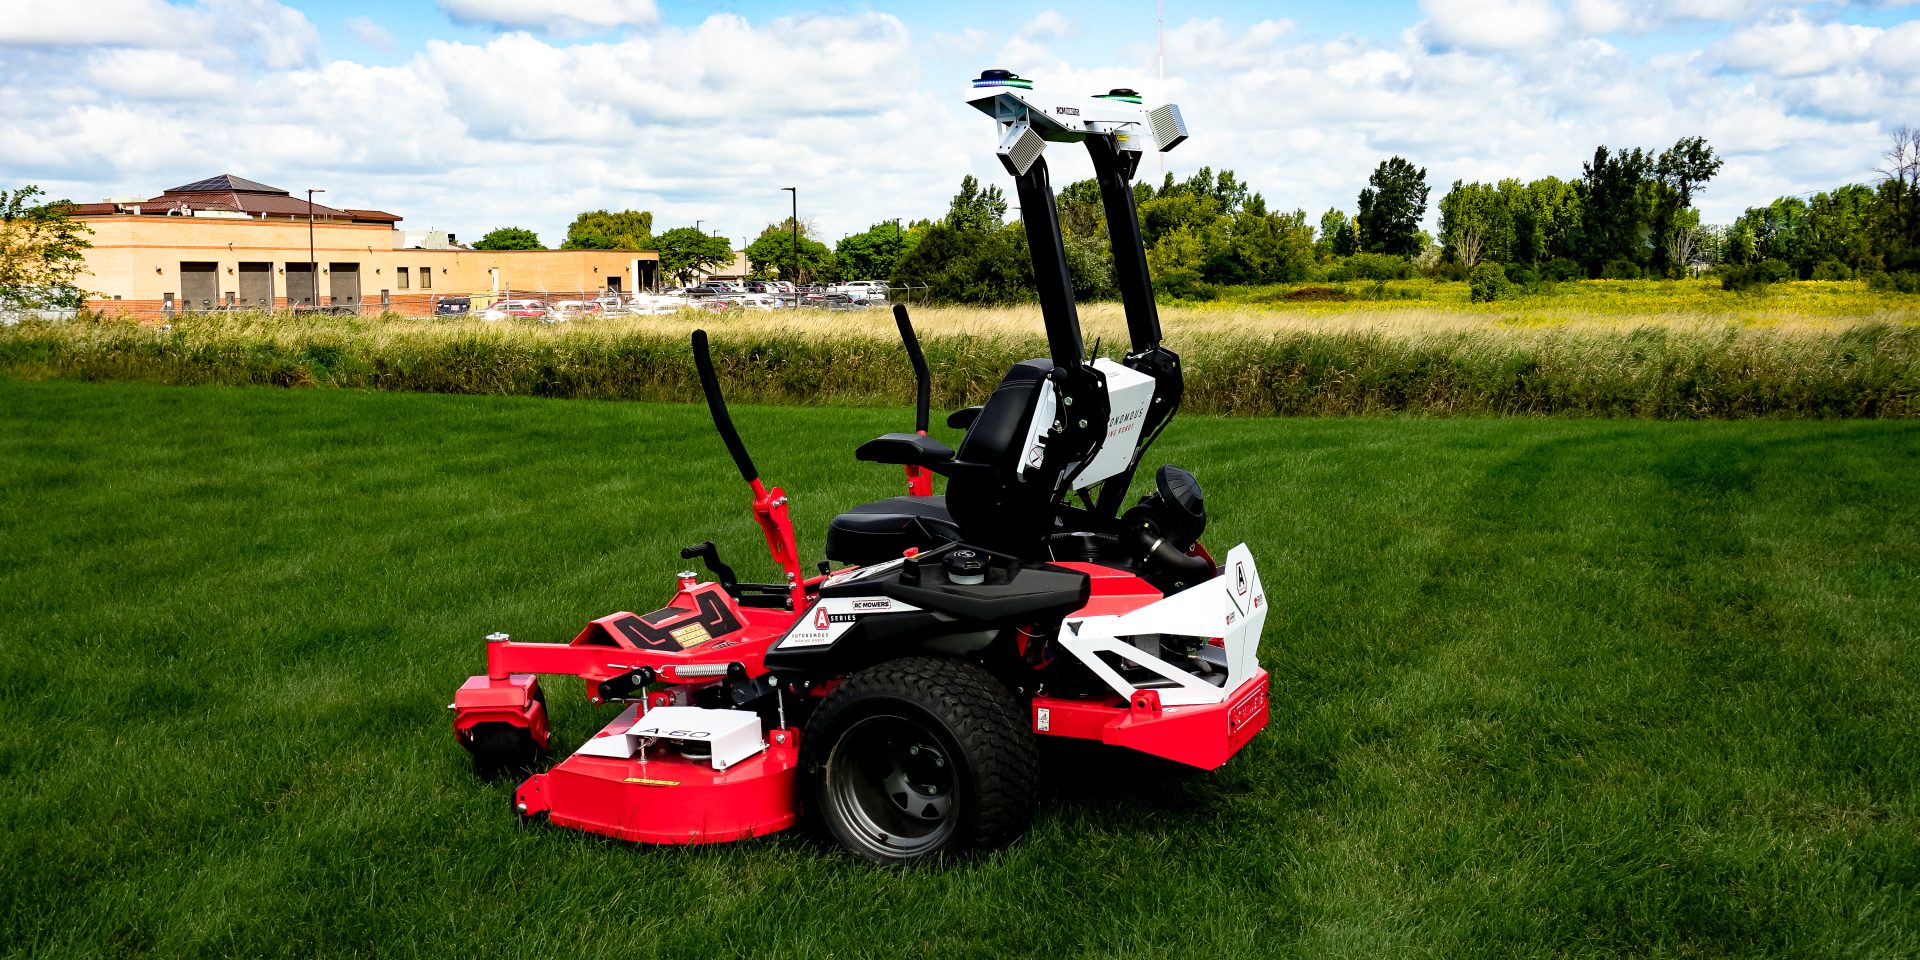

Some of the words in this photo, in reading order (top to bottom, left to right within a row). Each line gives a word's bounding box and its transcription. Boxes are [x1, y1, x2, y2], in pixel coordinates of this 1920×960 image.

[1108, 407, 1144, 428] ONOMOUS
[817, 610, 828, 627] A
[830, 614, 857, 622] SERIES
[638, 727, 711, 738] A-60
